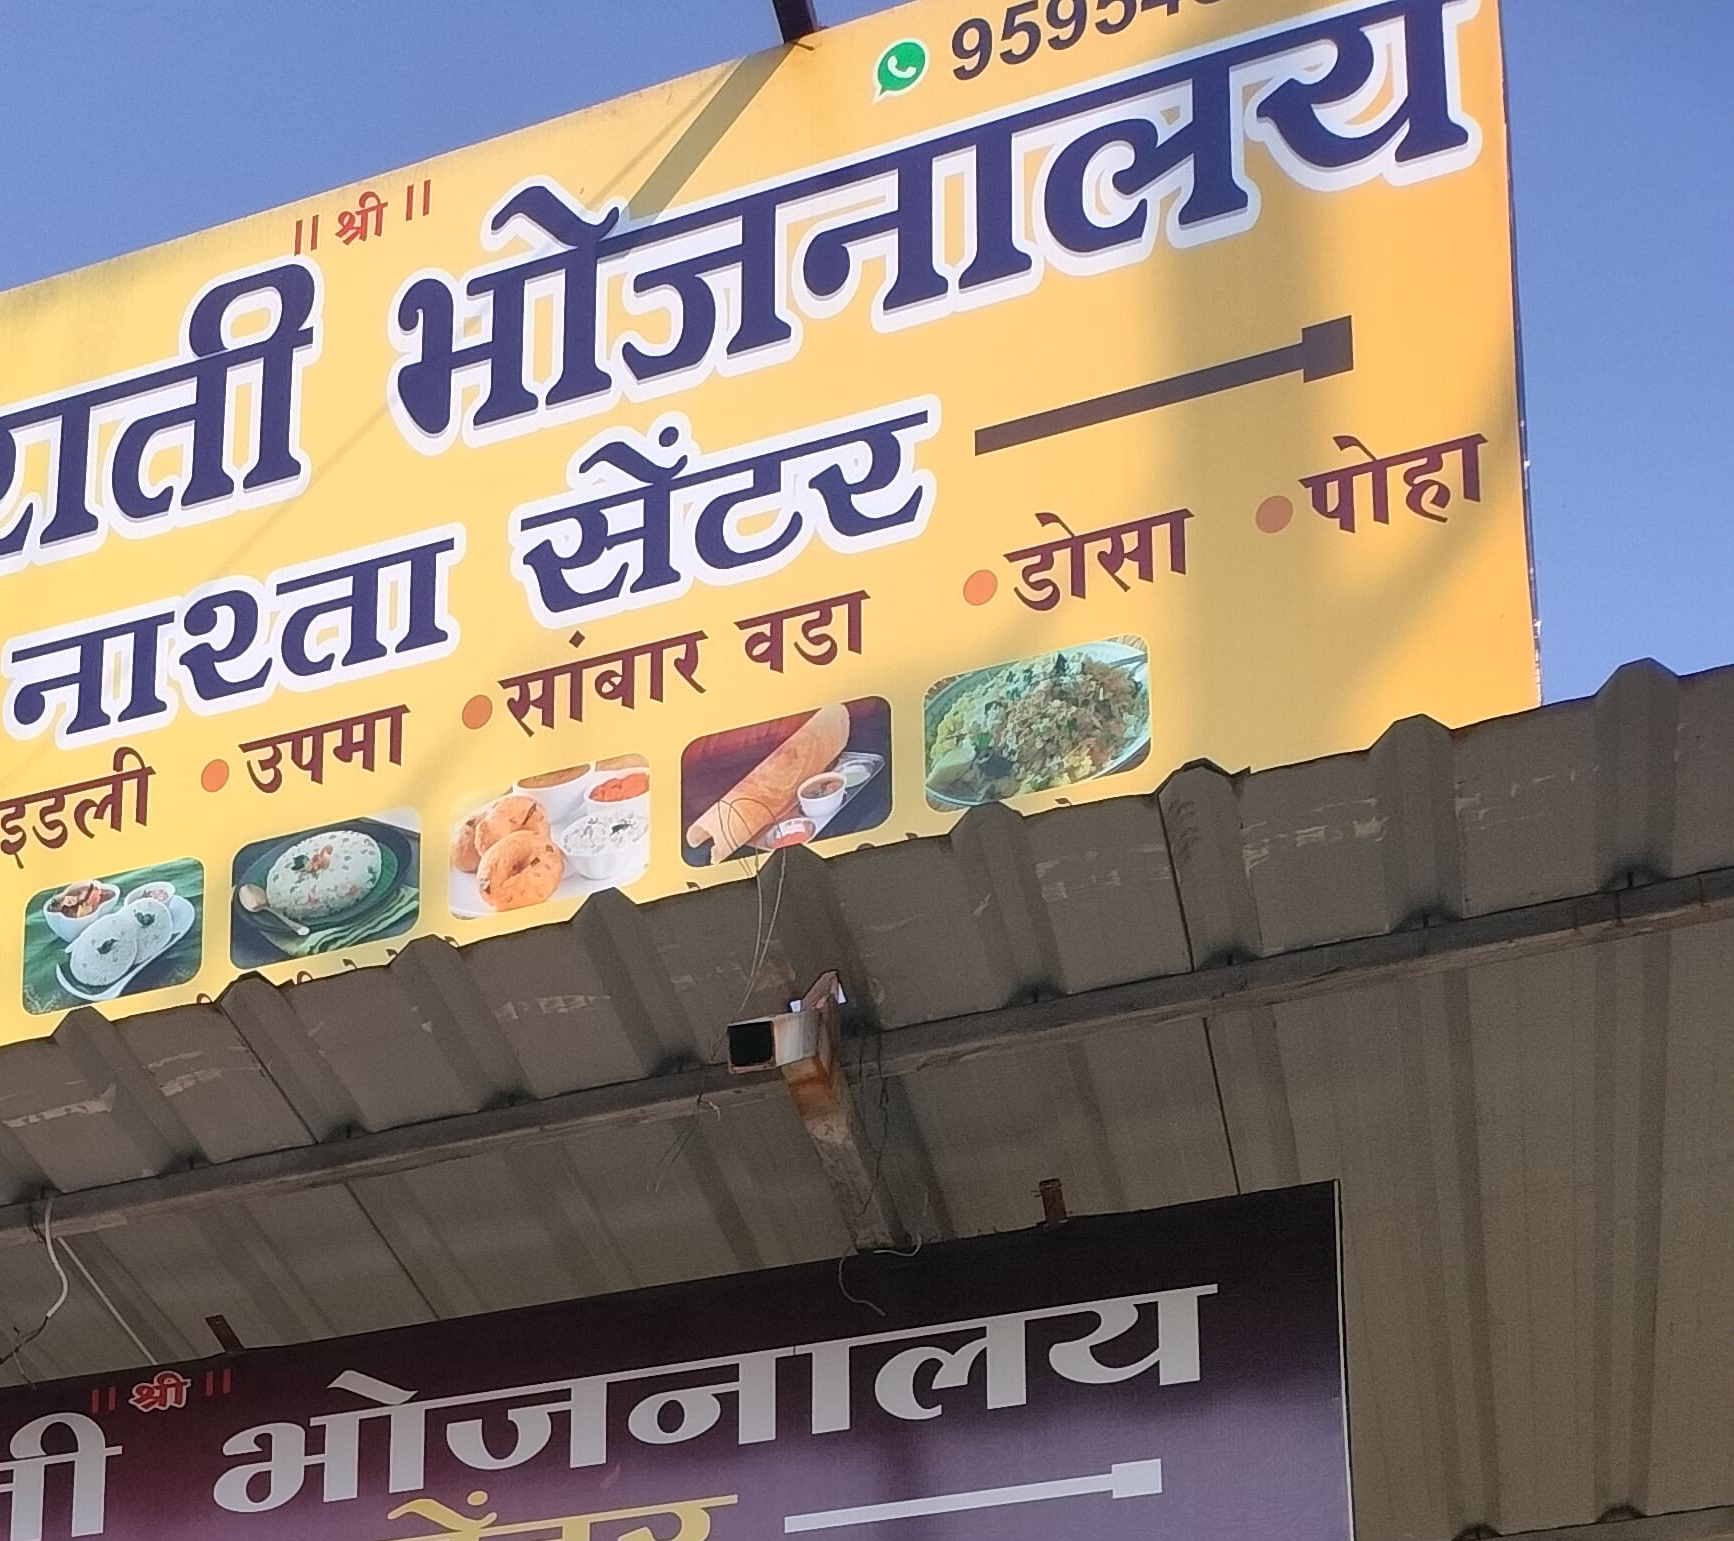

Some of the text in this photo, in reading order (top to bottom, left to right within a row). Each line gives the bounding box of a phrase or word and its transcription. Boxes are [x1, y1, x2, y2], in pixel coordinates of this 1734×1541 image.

[952, 0, 1181, 81] 9595
[396, 0, 1472, 440] भोजनालय
[10, 425, 930, 737] नाश्ता सेंटर
[239, 704, 411, 792] उपमा
[499, 631, 706, 738] सांबार
[735, 591, 870, 674] वडा
[1006, 508, 1194, 613] डोसा
[1299, 434, 1488, 534] पोहा
[129, 1370, 192, 1413] श्री
[214, 1284, 1218, 1514] भोजनालय
